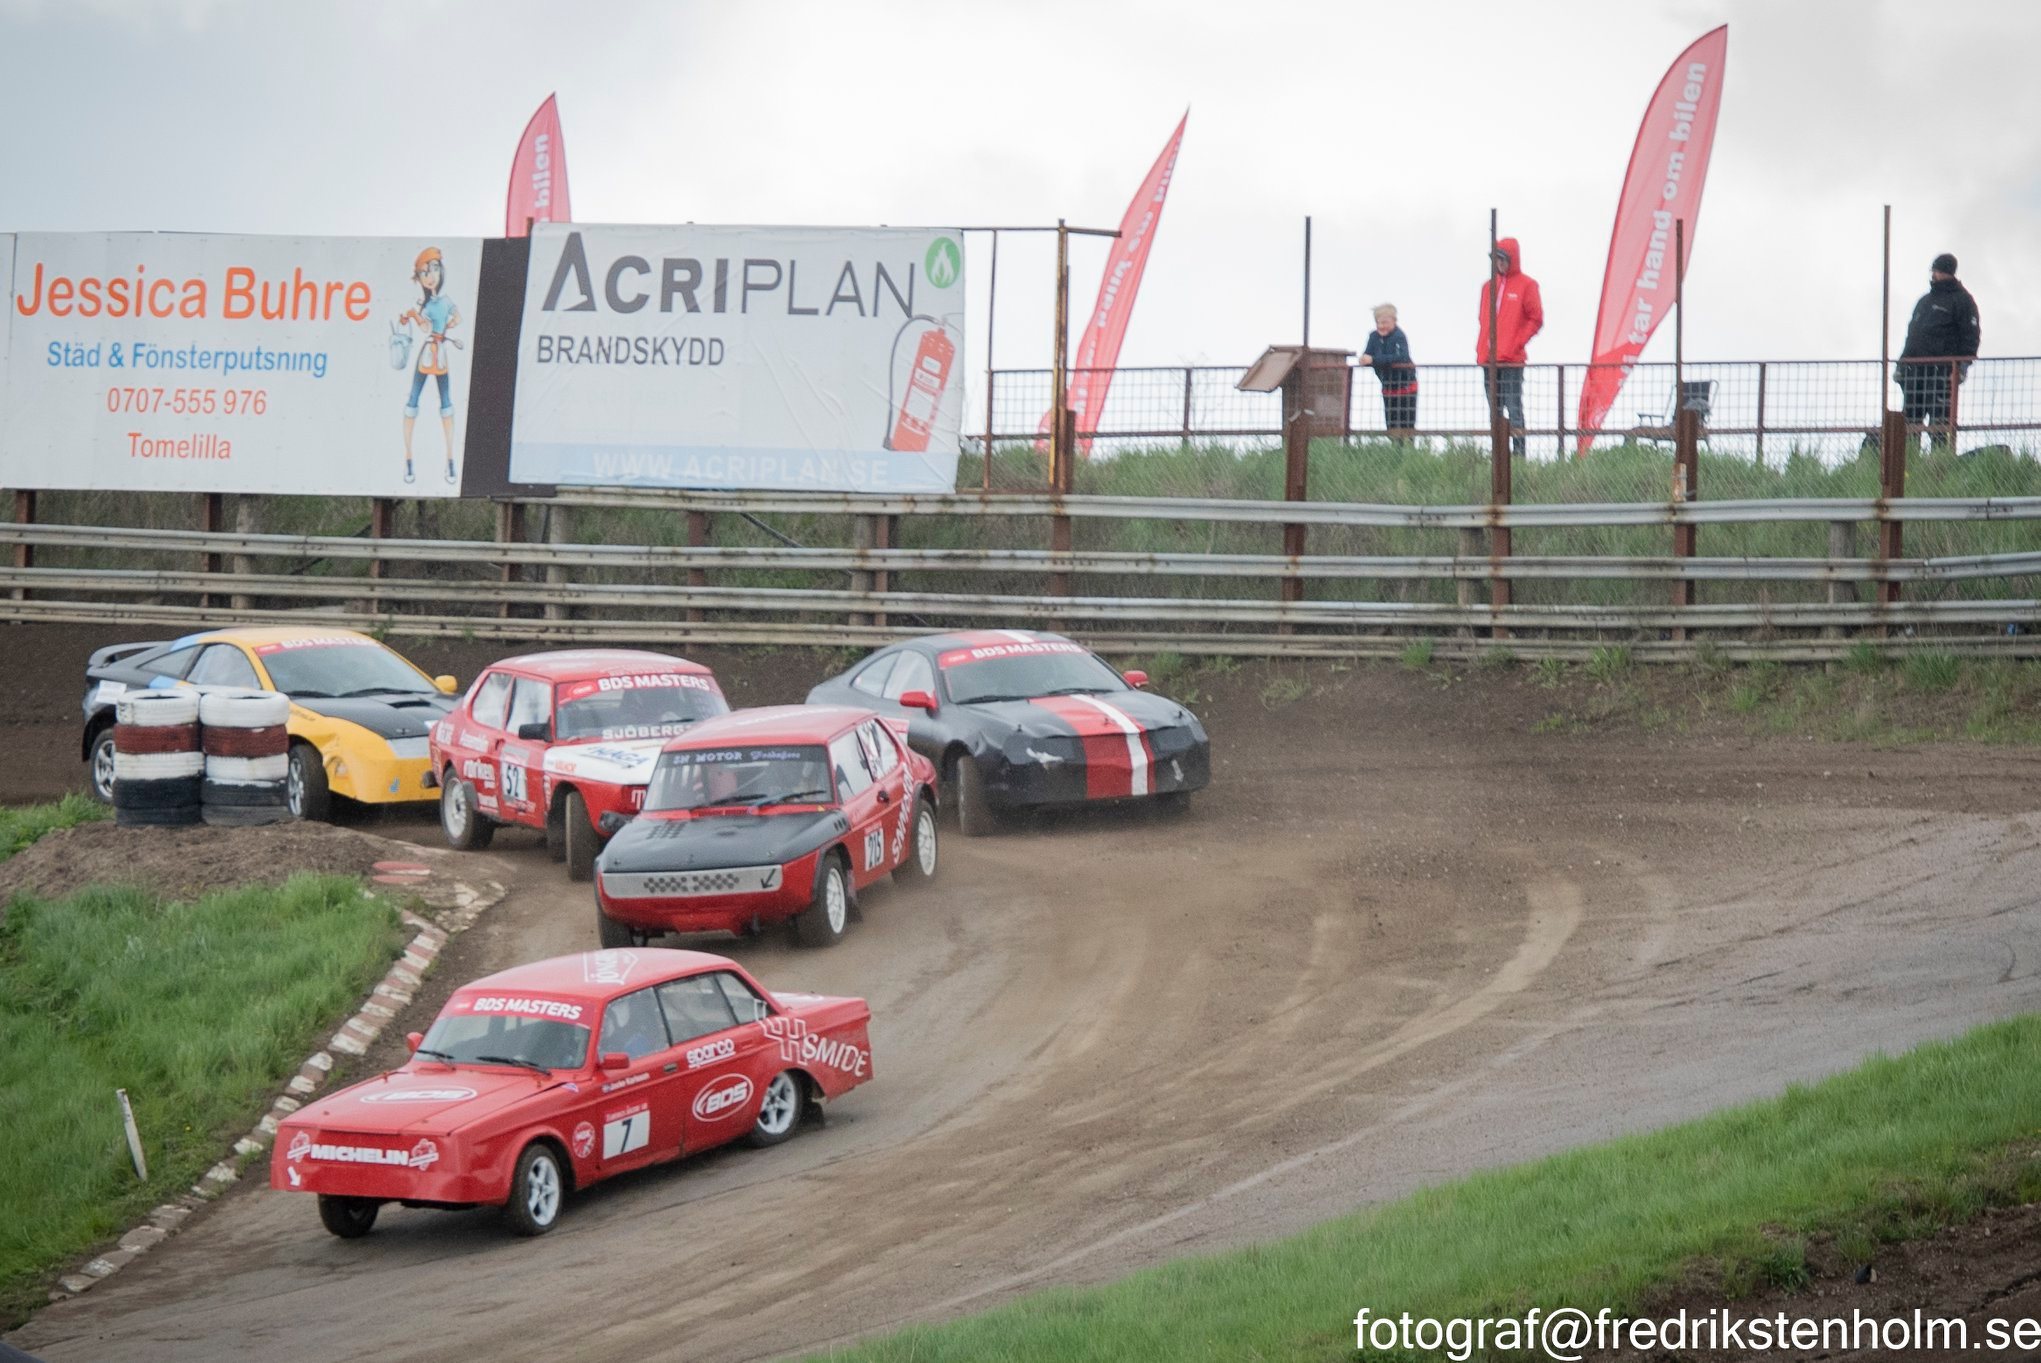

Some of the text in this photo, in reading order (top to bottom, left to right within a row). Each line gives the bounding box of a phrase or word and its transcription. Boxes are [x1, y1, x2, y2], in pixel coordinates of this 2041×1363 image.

[1668, 62, 1706, 143] bilen
[531, 133, 551, 208] bilen
[1662, 151, 1685, 201] om
[1636, 210, 1673, 290] hand
[541, 231, 916, 318] ACRIPLAN
[17, 262, 372, 322] Jessica Buhre
[1627, 297, 1654, 345] tar
[47, 341, 328, 378] Städ & Fönsterputsning
[537, 335, 725, 366] BRANDSKYDD
[107, 388, 267, 416] 0707-555 976
[128, 432, 232, 460] Tomelilla
[970, 645, 1007, 660] BDS
[1004, 642, 1083, 655] MASTERS
[597, 675, 634, 692] BDS
[634, 674, 710, 692] MASTERS
[695, 751, 742, 763] MOTOR
[505, 764, 521, 798] 52
[473, 997, 583, 1021] BDS MASTERS
[686, 1038, 736, 1067] sparco
[801, 1033, 869, 1078] SMIDE
[706, 1081, 748, 1114] BDS
[621, 1118, 633, 1153] 7
[310, 1143, 409, 1166] MICHELIN
